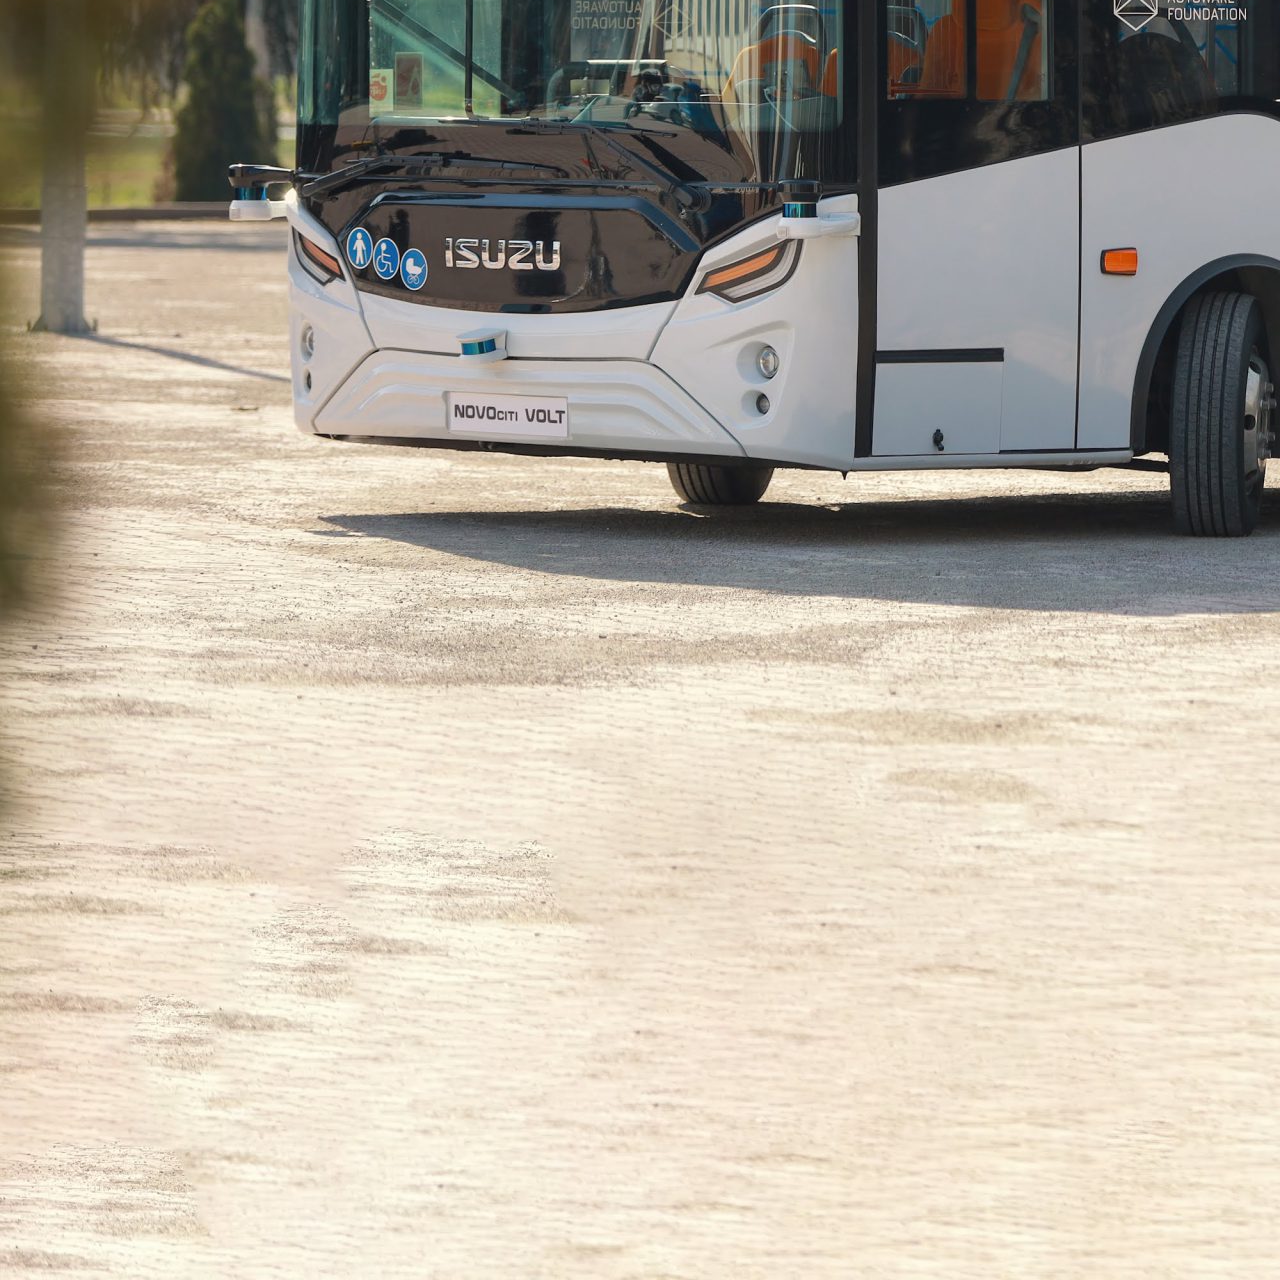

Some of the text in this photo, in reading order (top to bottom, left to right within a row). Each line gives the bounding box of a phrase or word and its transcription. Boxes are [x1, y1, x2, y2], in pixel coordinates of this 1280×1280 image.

[1167, 7, 1247, 21] FOUNDATION
[445, 237, 561, 271] ISUZU
[525, 408, 566, 424] VOLT
